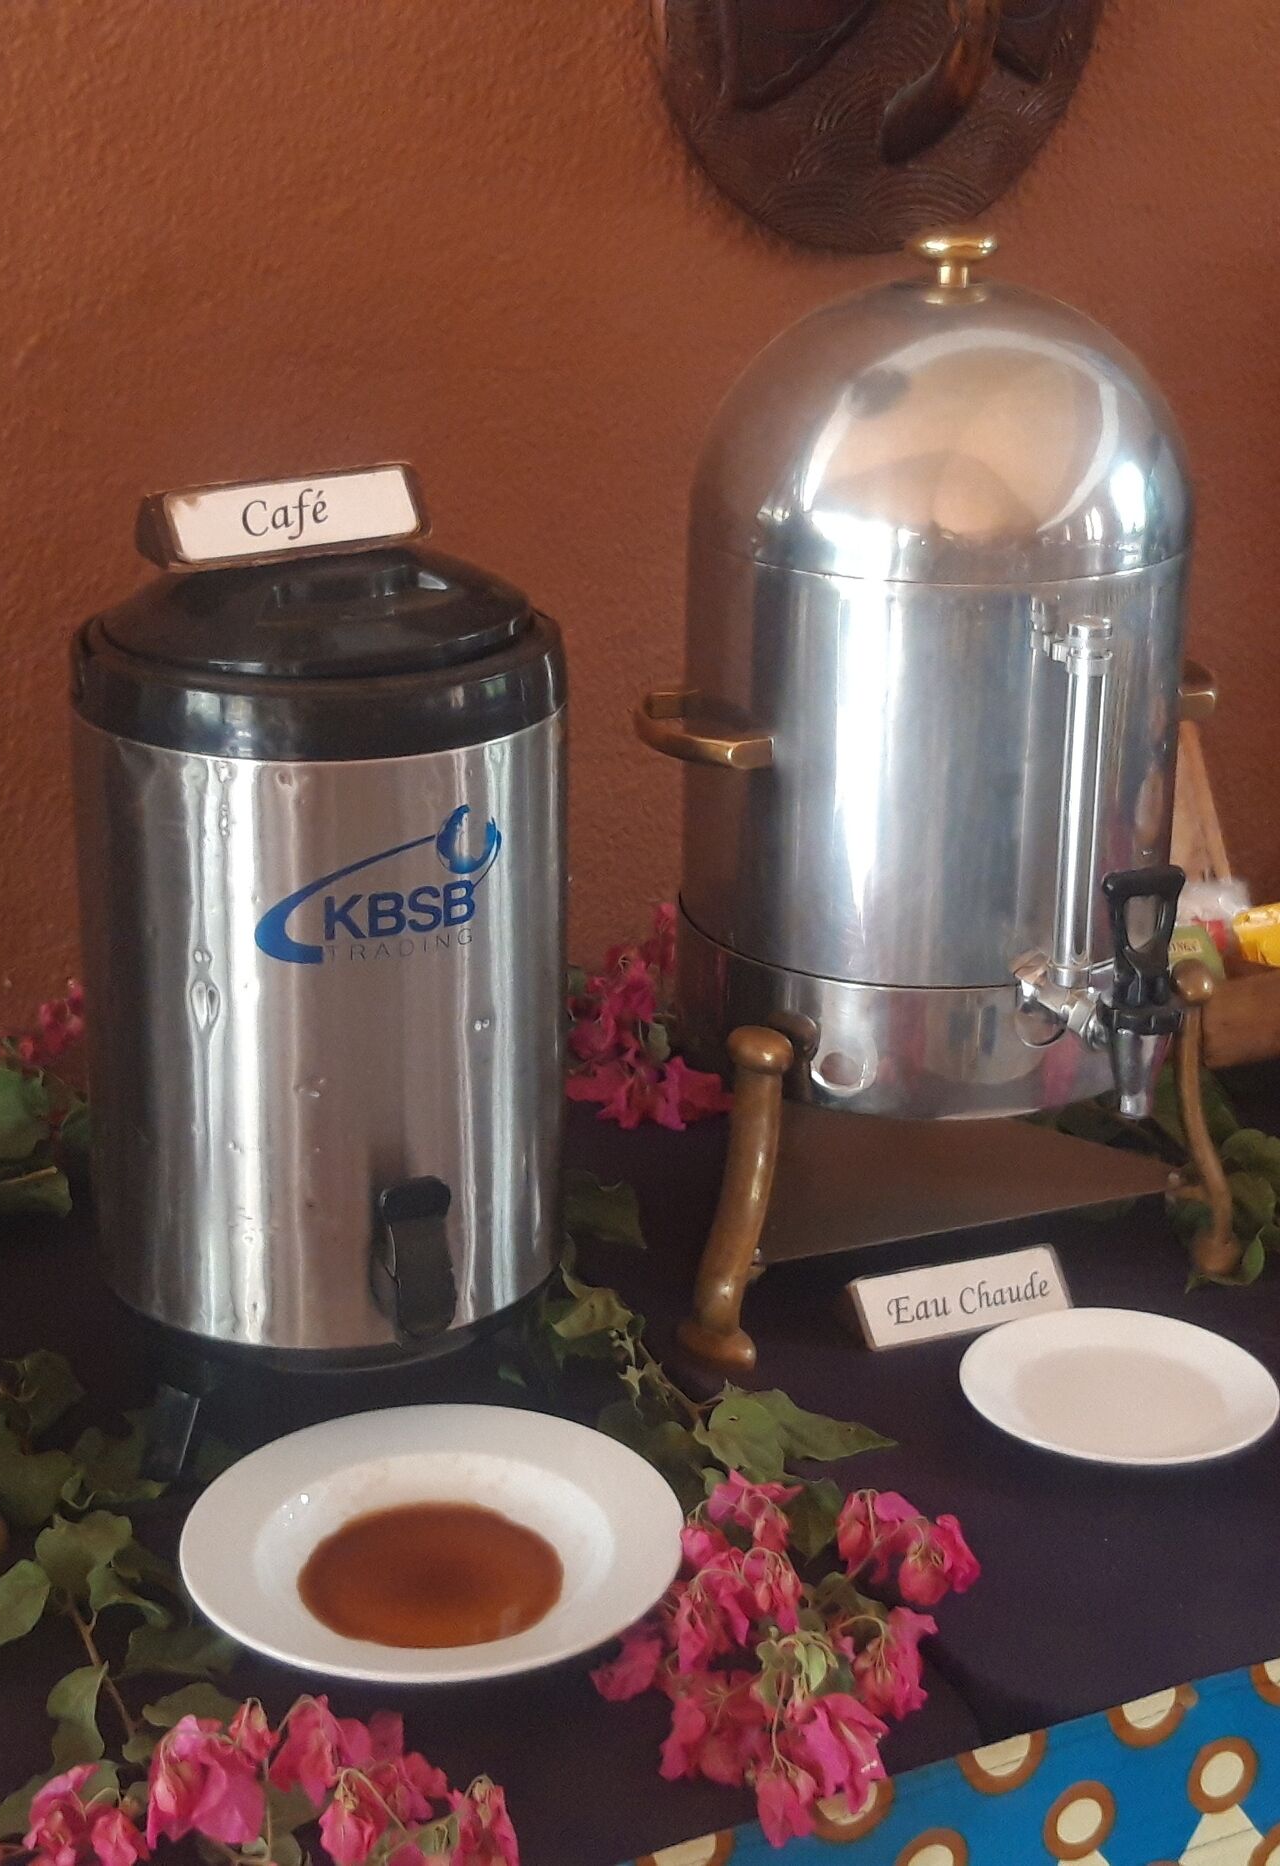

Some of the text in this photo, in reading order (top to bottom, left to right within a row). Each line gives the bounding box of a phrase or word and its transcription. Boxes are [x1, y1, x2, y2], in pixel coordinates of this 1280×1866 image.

[241, 488, 328, 541] Café
[324, 879, 476, 941] KBSB
[326, 928, 474, 961] TRADING
[887, 1271, 1051, 1325] Eau Chaude
